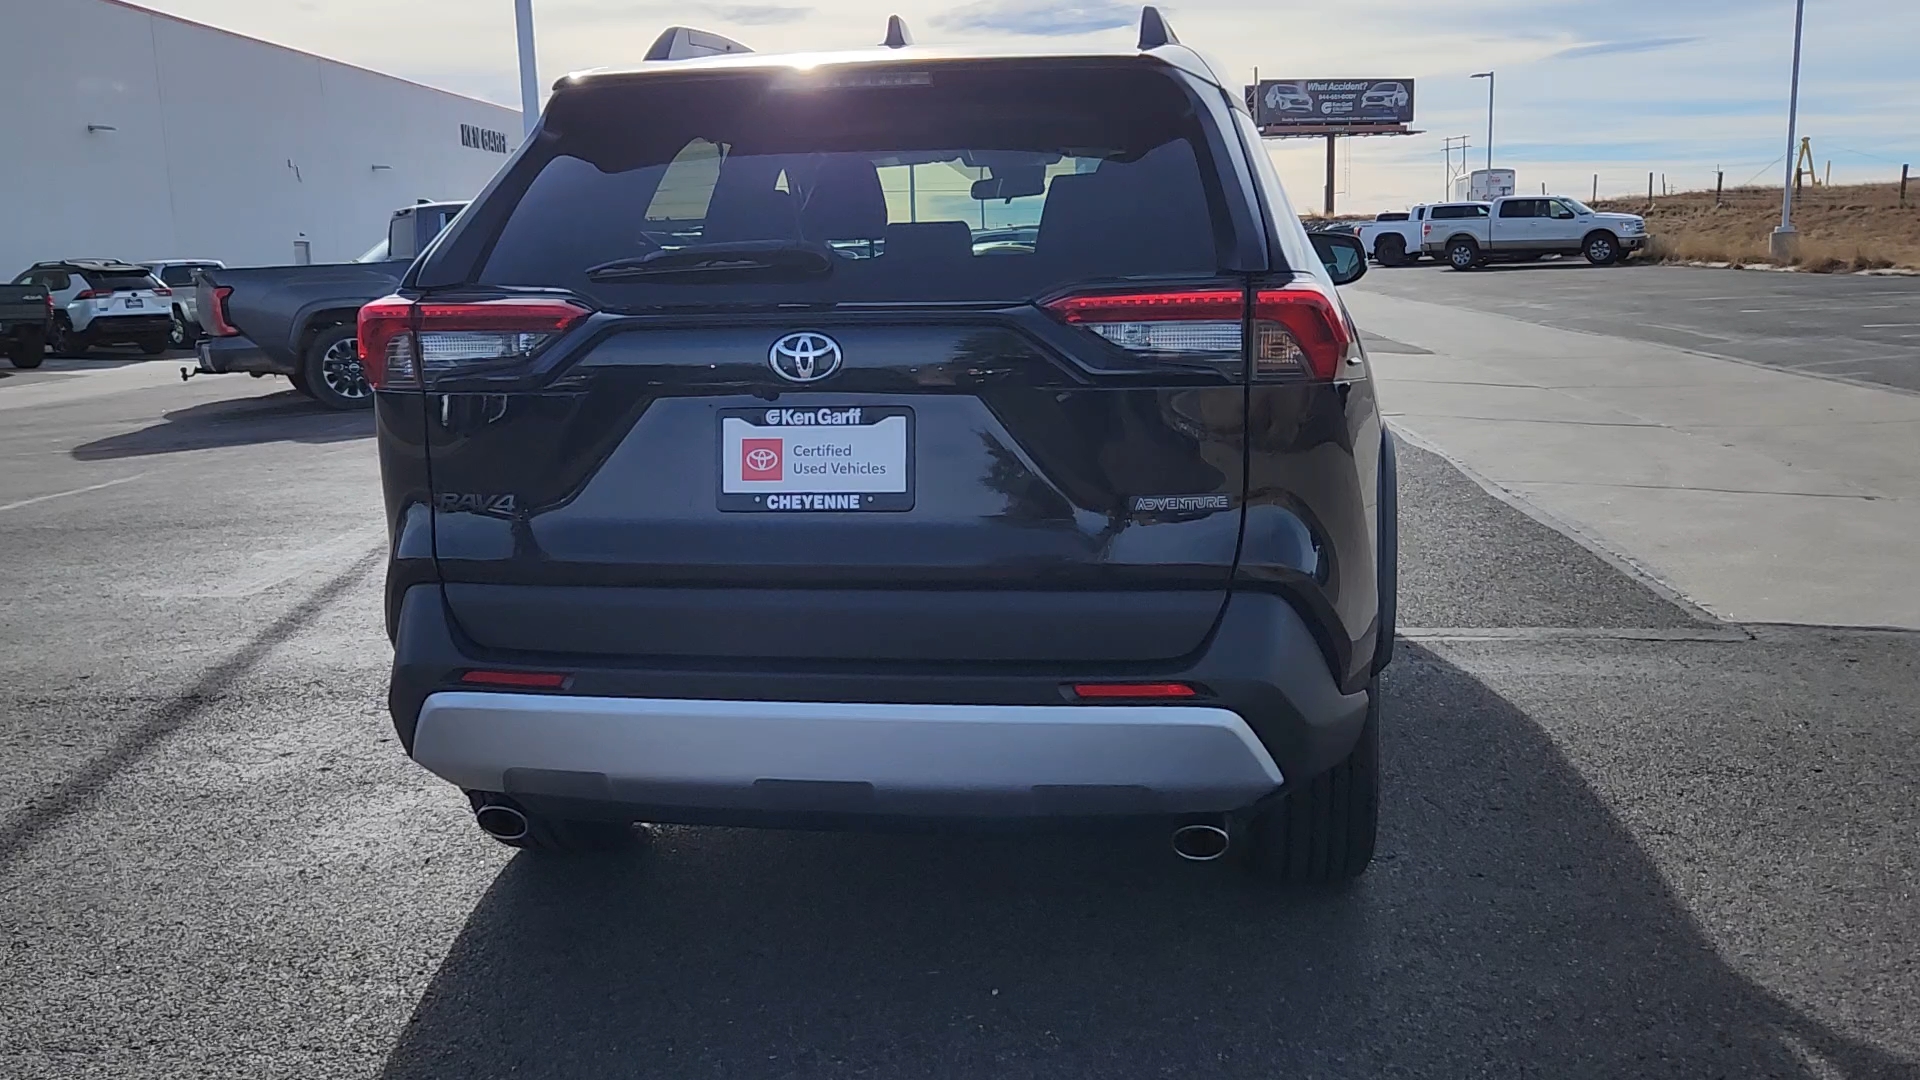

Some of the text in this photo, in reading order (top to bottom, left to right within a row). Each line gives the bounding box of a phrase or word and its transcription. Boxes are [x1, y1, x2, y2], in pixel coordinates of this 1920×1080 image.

[1307, 81, 1369, 91] What Accident?
[782, 408, 862, 425] Ken Garff
[793, 443, 852, 457] Certified
[793, 462, 886, 475] Used Vehicles
[439, 493, 515, 513] RAV4
[766, 494, 860, 510] CHEYENNE
[1134, 496, 1229, 511] ADVENTURE
